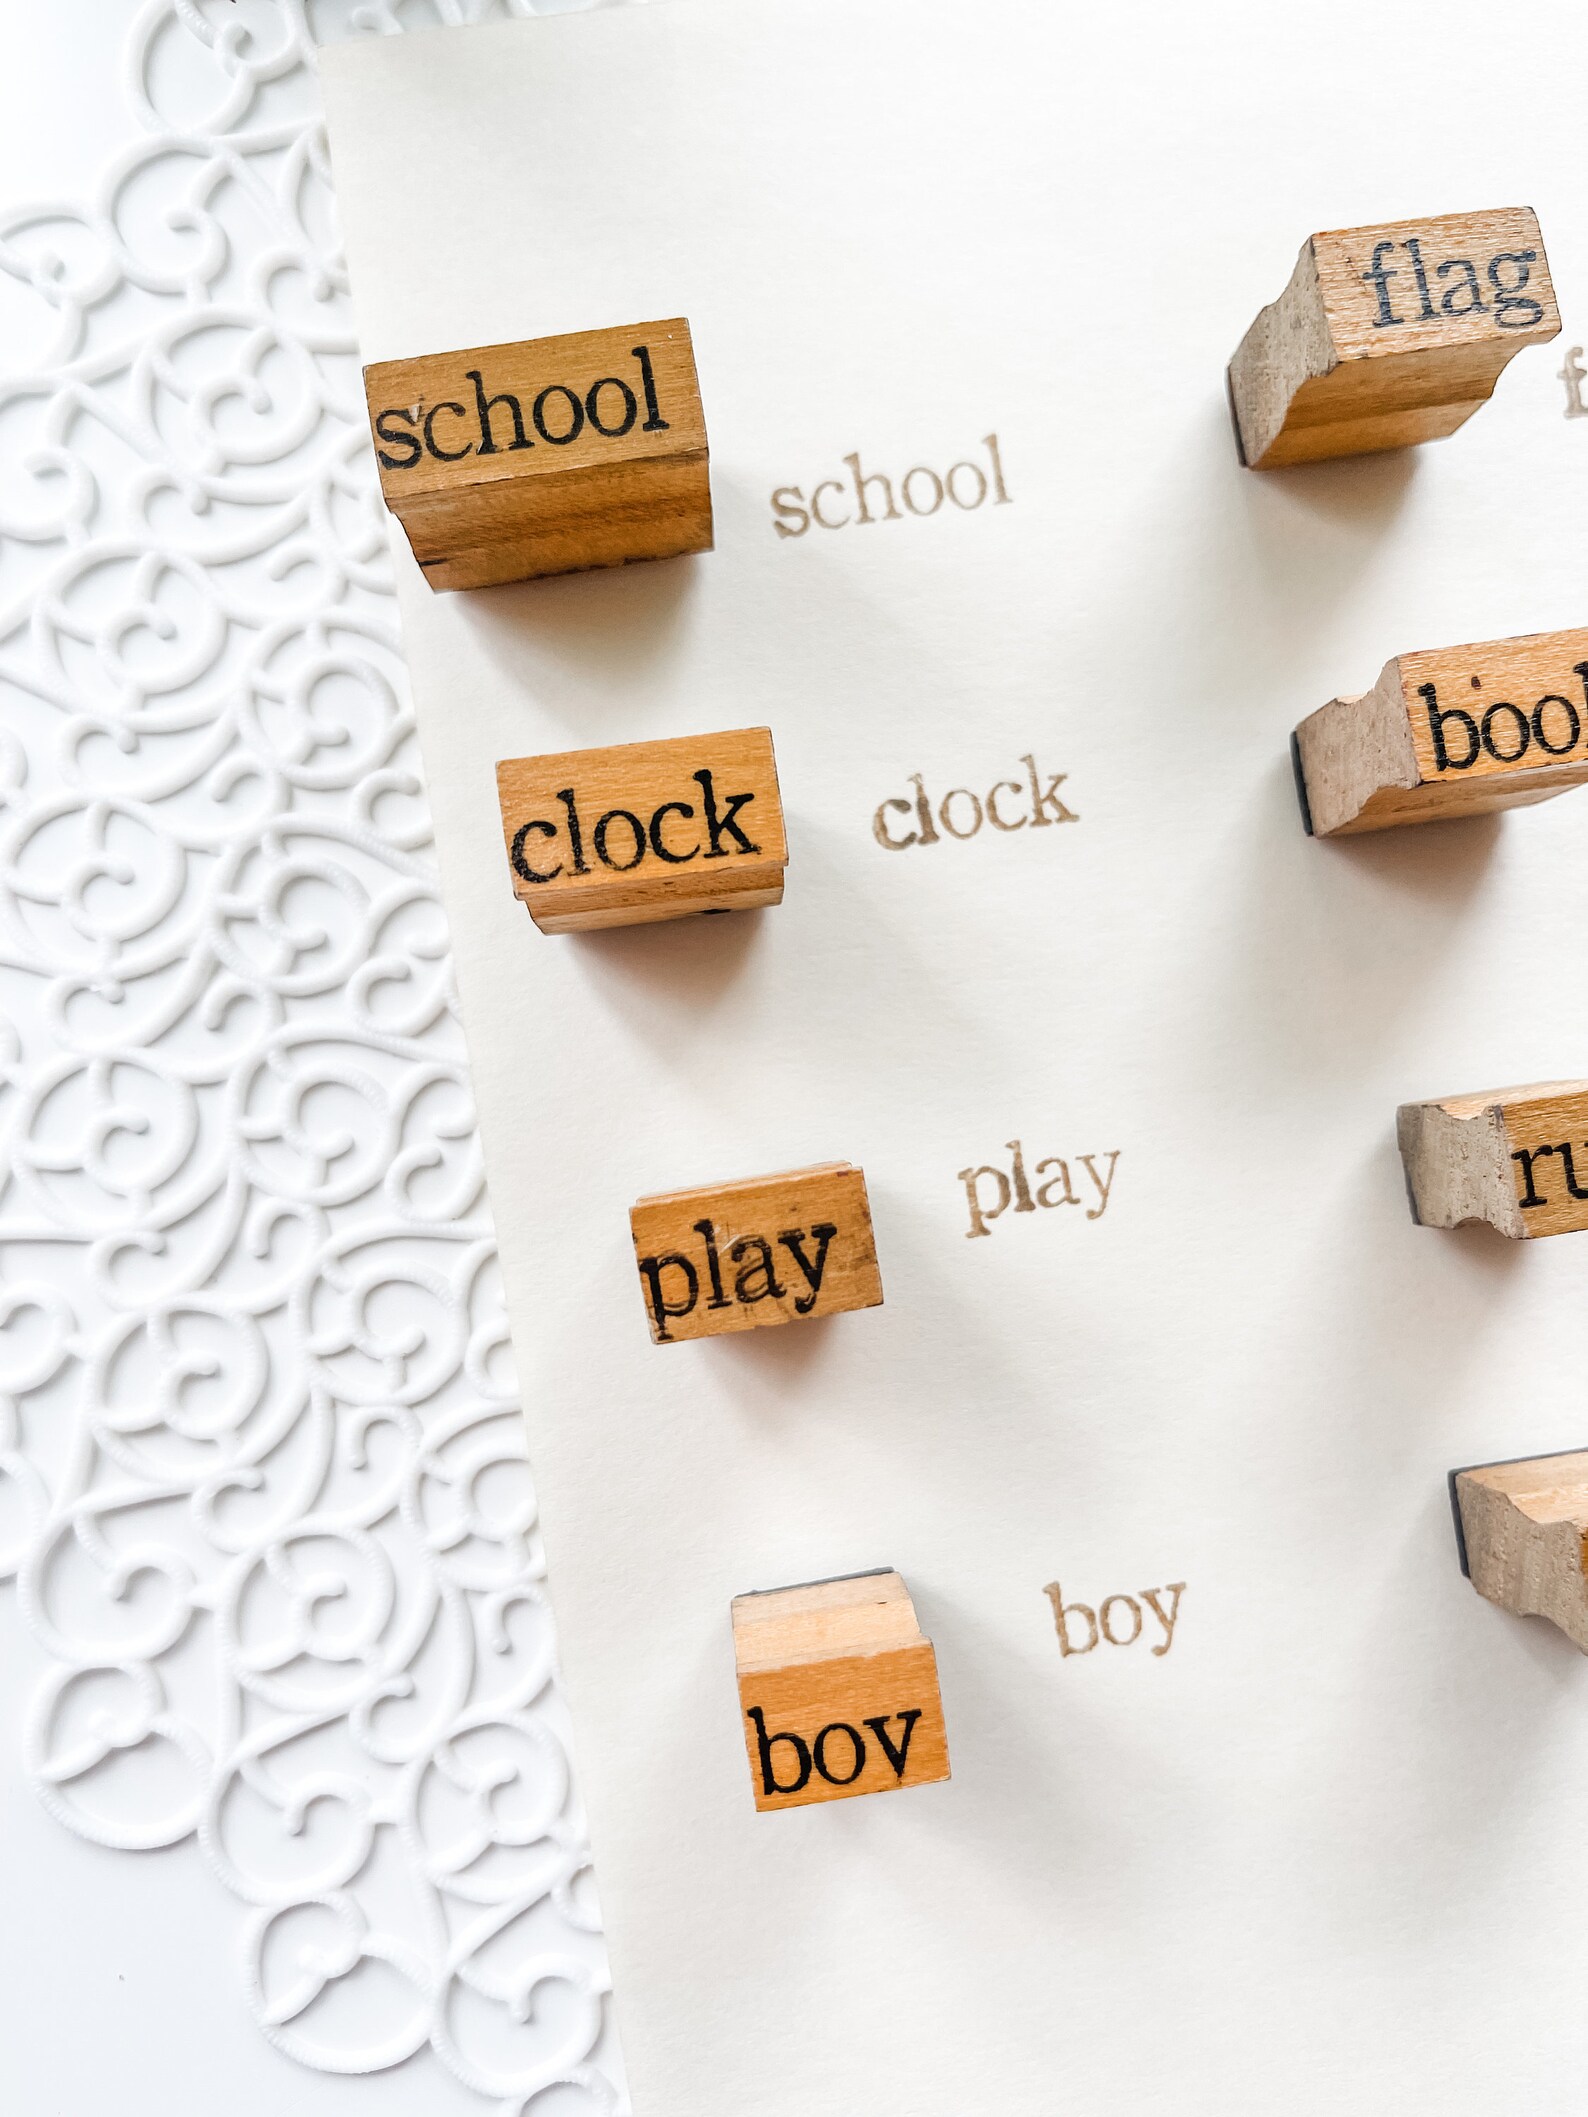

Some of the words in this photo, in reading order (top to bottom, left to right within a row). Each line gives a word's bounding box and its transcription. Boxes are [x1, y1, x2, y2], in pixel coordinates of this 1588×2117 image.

[1363, 239, 1543, 328] flag
[376, 346, 670, 470] school
[770, 433, 1014, 539] school
[511, 769, 762, 884] clock
[872, 754, 1080, 851] clock
[957, 1140, 1121, 1239] play
[640, 1219, 837, 1340] play
[1042, 1581, 1186, 1658] boy
